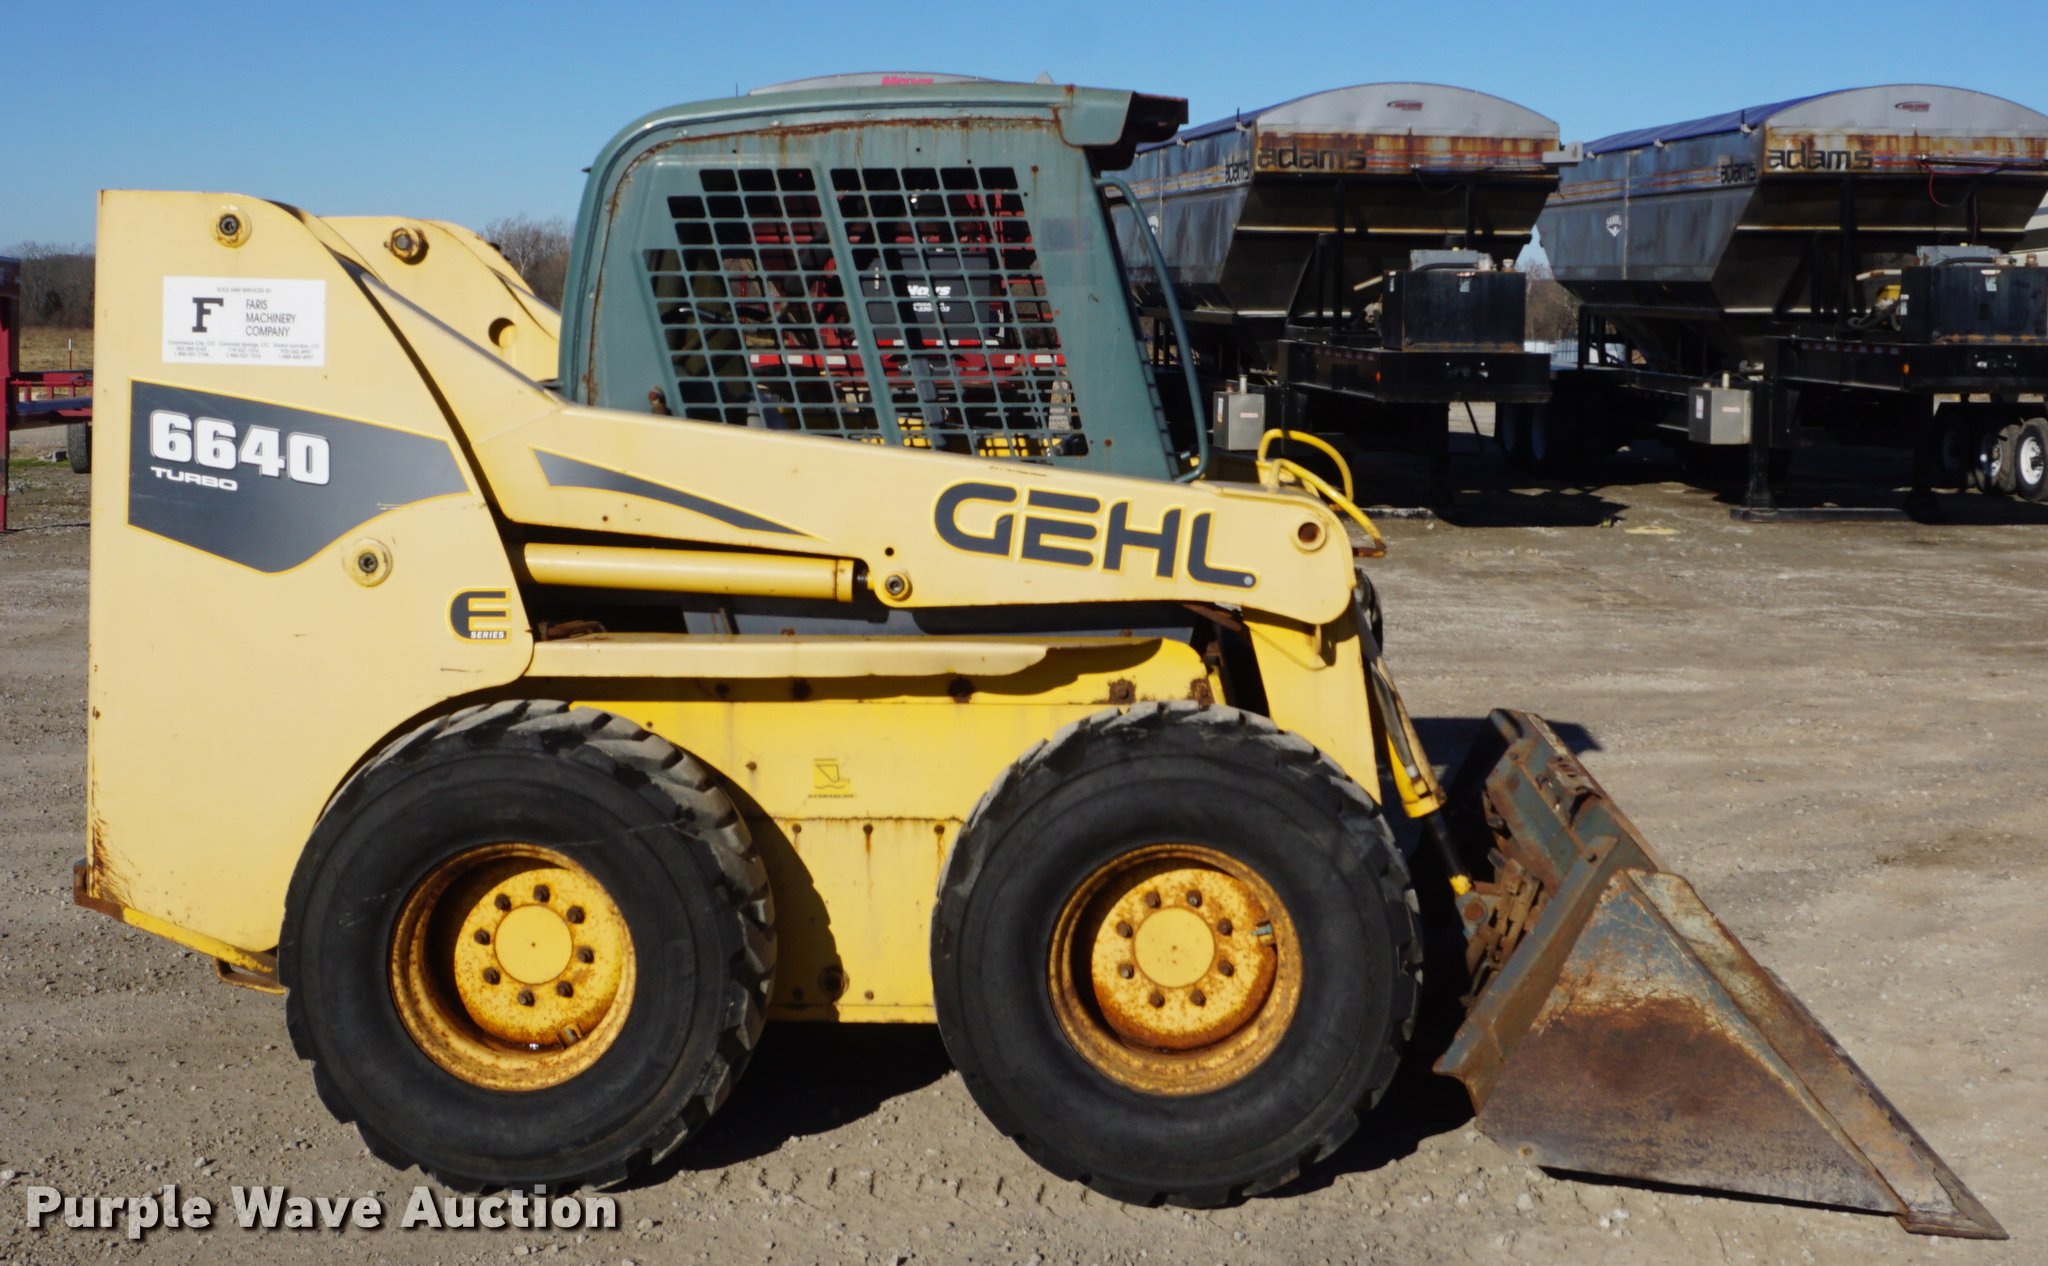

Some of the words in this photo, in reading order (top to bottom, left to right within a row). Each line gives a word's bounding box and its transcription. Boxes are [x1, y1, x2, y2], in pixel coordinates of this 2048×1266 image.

[1257, 142, 1367, 170] adams
[1768, 141, 1873, 170] adams
[1721, 161, 1756, 185] adams
[192, 297, 224, 333] F
[246, 299, 268, 310] FARIS
[245, 313, 296, 325] MACHINERY
[245, 325, 290, 337] COMPANY
[150, 409, 330, 486] 6640
[150, 465, 238, 492] TURBO
[934, 482, 1256, 588] GEHL
[449, 590, 507, 640] E
[470, 630, 505, 639] SERIES
